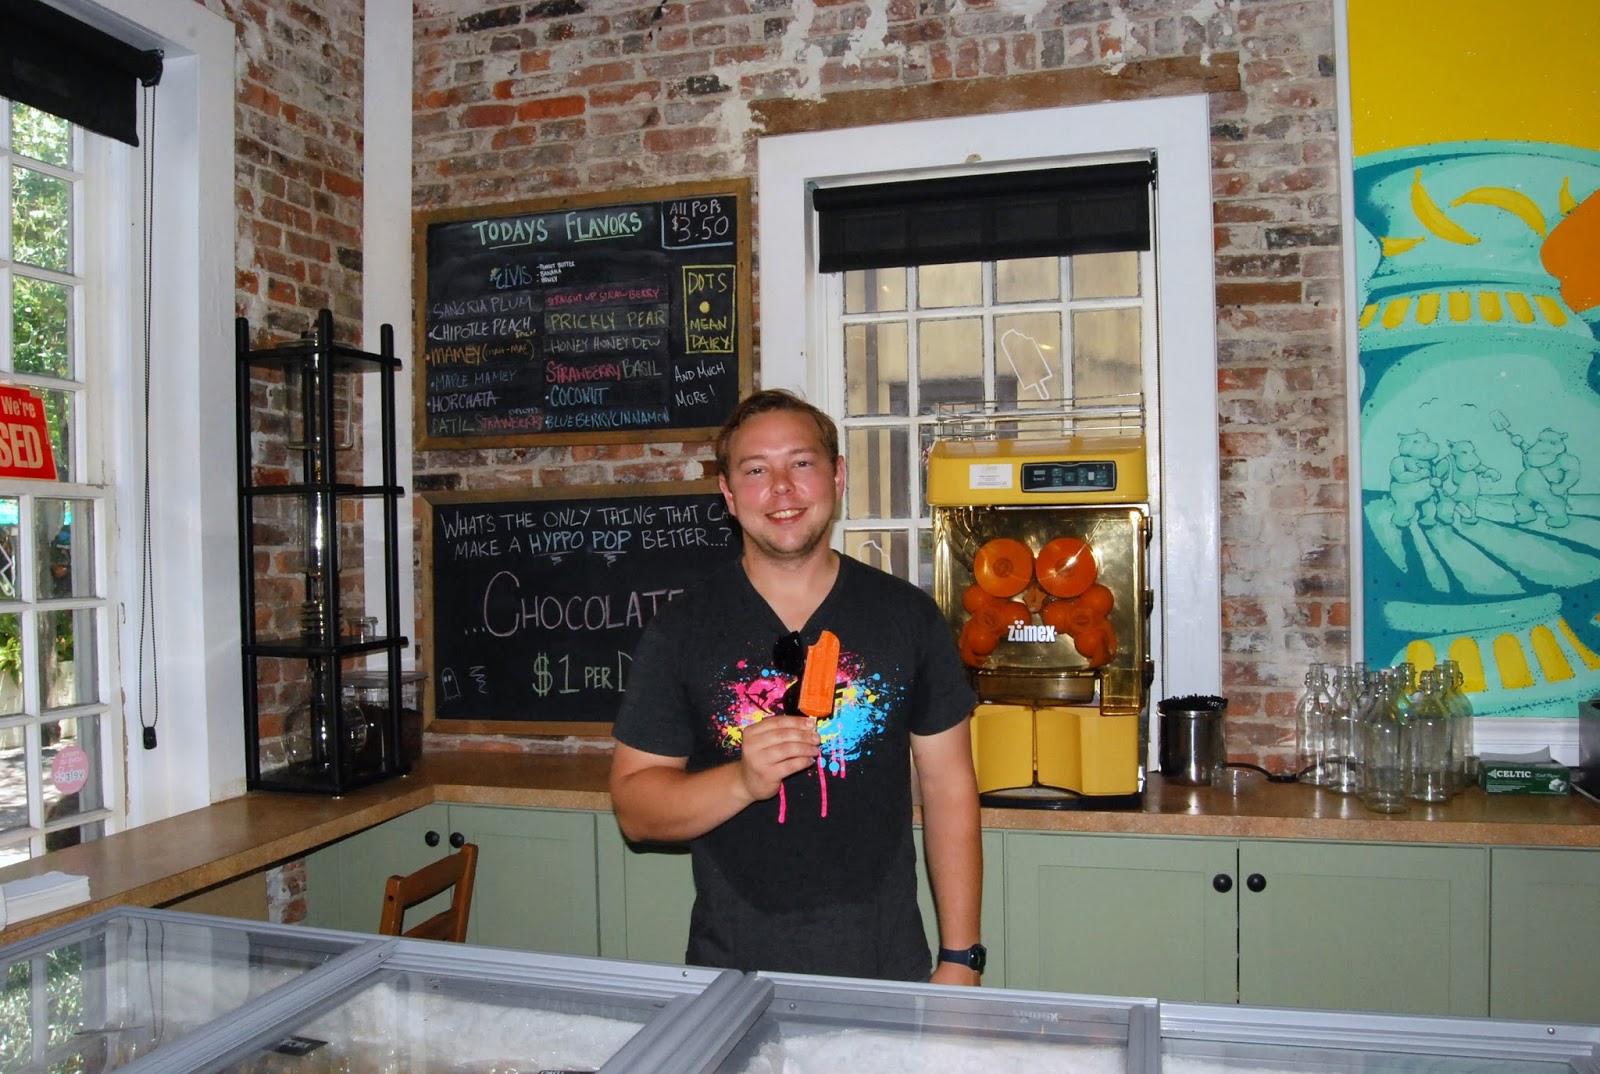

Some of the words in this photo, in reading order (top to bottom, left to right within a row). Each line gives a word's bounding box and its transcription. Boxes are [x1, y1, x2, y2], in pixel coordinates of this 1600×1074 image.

[472, 219, 549, 245] TODAYS
[565, 211, 643, 240] FLAVORS
[672, 215, 729, 242] $3.50
[433, 299, 487, 320] SANGRIA
[490, 295, 532, 313] PLUM
[547, 293, 582, 307] STRAIGHT
[585, 291, 597, 301] UP
[600, 288, 660, 303] STRAWBERRY
[432, 321, 490, 341] CHIPOTLE
[492, 316, 532, 335] PEACH
[551, 312, 615, 331] PRICKLY
[627, 309, 665, 328] PEAR
[690, 316, 727, 332] MEAN
[551, 338, 588, 355] HONEY
[689, 334, 731, 350] DAIRY
[431, 345, 481, 367] MAMEY
[435, 373, 469, 391] MAPLE
[474, 369, 518, 386] MAMEY
[546, 360, 621, 383] STRAWBERRY
[621, 358, 662, 379] BASIL
[674, 365, 696, 383] AND
[697, 360, 726, 379] MUCH
[0, 396, 36, 418] We're
[432, 390, 500, 413] HORCHATA
[550, 384, 609, 407] COCONUT
[432, 417, 474, 434] DATIL
[500, 512, 536, 531] THE
[543, 507, 591, 527] ONLY
[599, 503, 656, 526] THING
[659, 504, 699, 525] THAT
[454, 539, 501, 561] MAKE
[508, 536, 522, 553] A
[528, 530, 584, 554] HYPPO
[592, 530, 632, 550] POP
[464, 570, 684, 637] ...CHOCOLAT
[584, 666, 614, 690] PER
[1496, 770, 1531, 778] CELTIC
